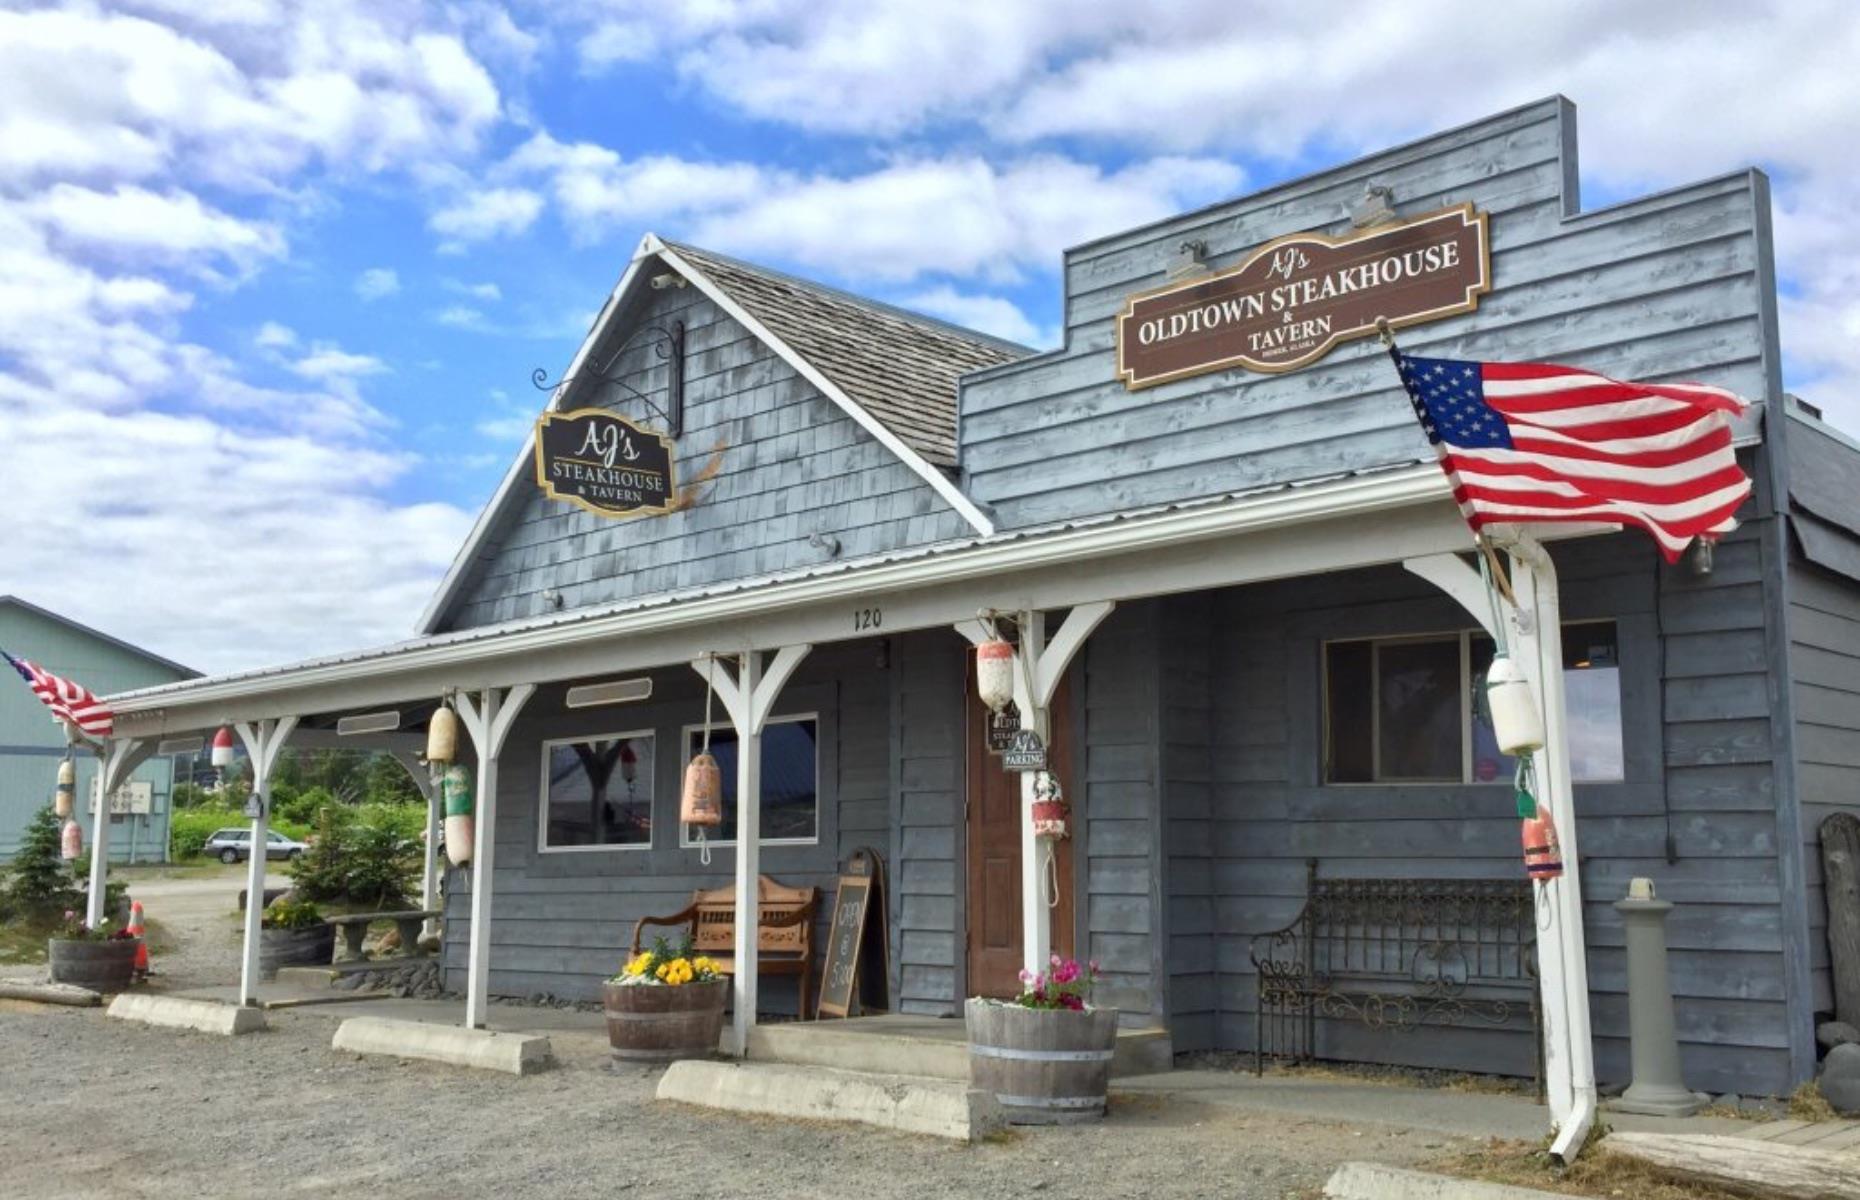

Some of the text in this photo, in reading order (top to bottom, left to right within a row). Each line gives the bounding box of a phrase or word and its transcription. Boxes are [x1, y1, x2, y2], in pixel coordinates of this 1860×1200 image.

[1265, 247, 1310, 280] AJ's
[1138, 240, 1460, 346] OLDTOWN STEAKHOUSE
[1247, 314, 1332, 351] TAVERN
[1283, 311, 1293, 323] &
[574, 420, 640, 469] AJ's
[553, 462, 664, 492] STEAKHOUSE
[578, 485, 642, 502] & TAVERN
[855, 608, 882, 632] 120
